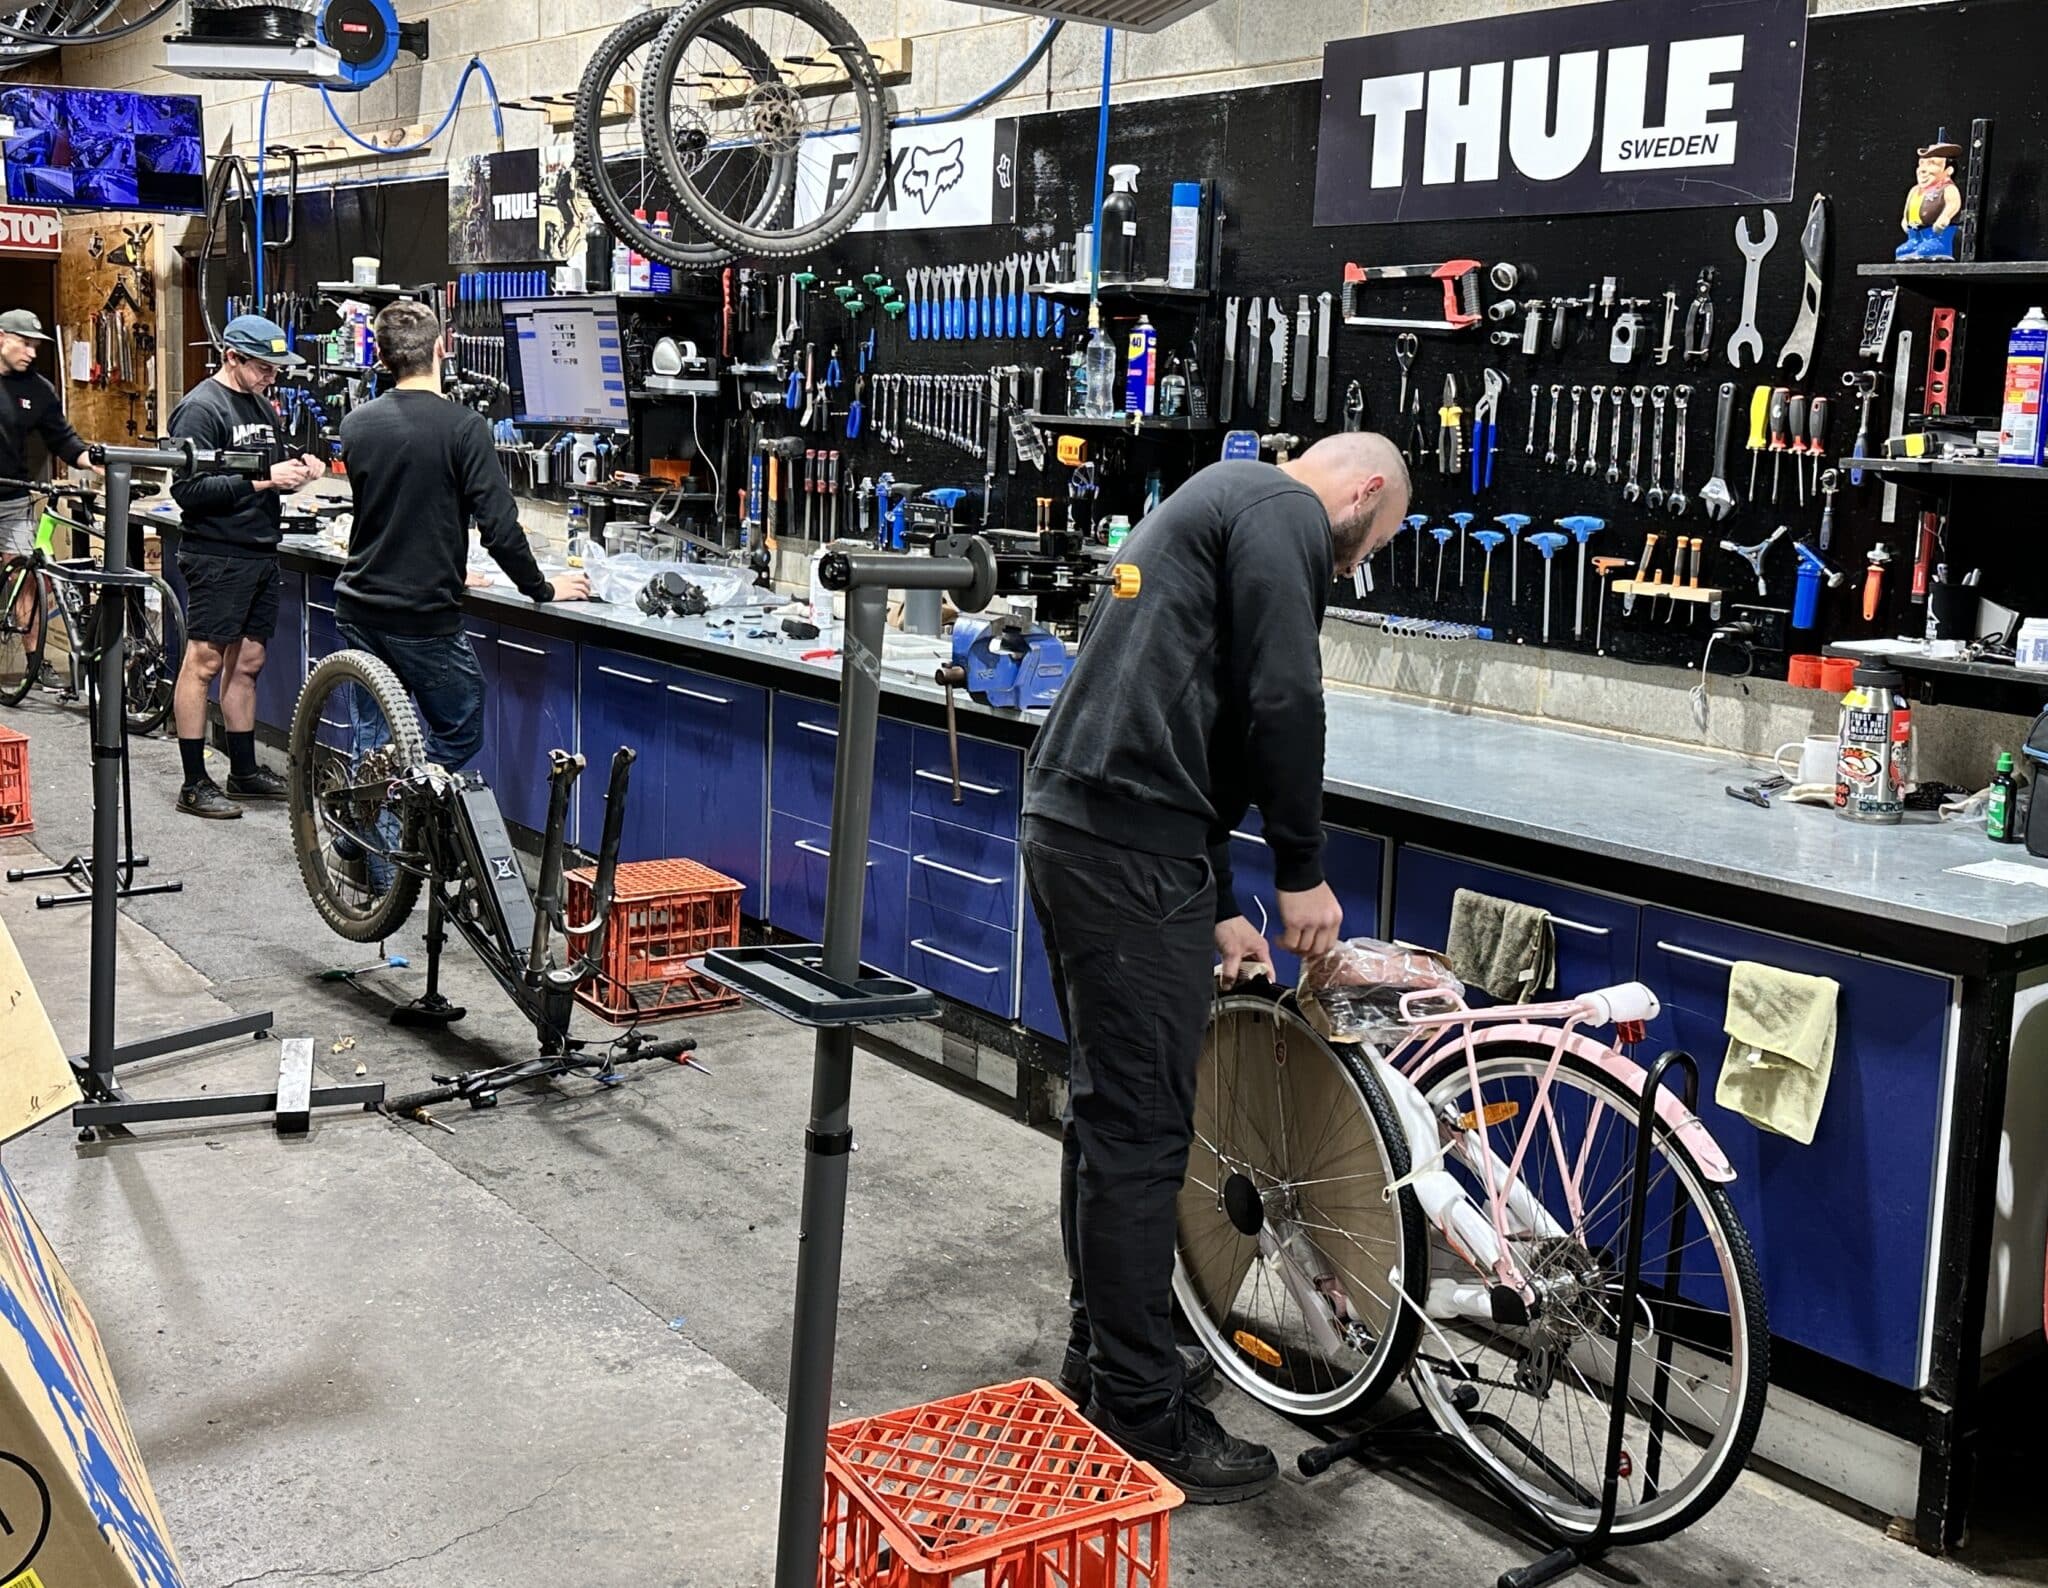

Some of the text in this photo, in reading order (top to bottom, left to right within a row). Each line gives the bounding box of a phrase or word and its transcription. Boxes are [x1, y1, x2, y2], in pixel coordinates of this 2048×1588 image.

[1360, 34, 1744, 189] THULE
[1618, 133, 1719, 160] SWEDEN
[825, 146, 909, 213] FX
[492, 192, 537, 220] THULE
[1850, 726, 1886, 736] MECHANIC
